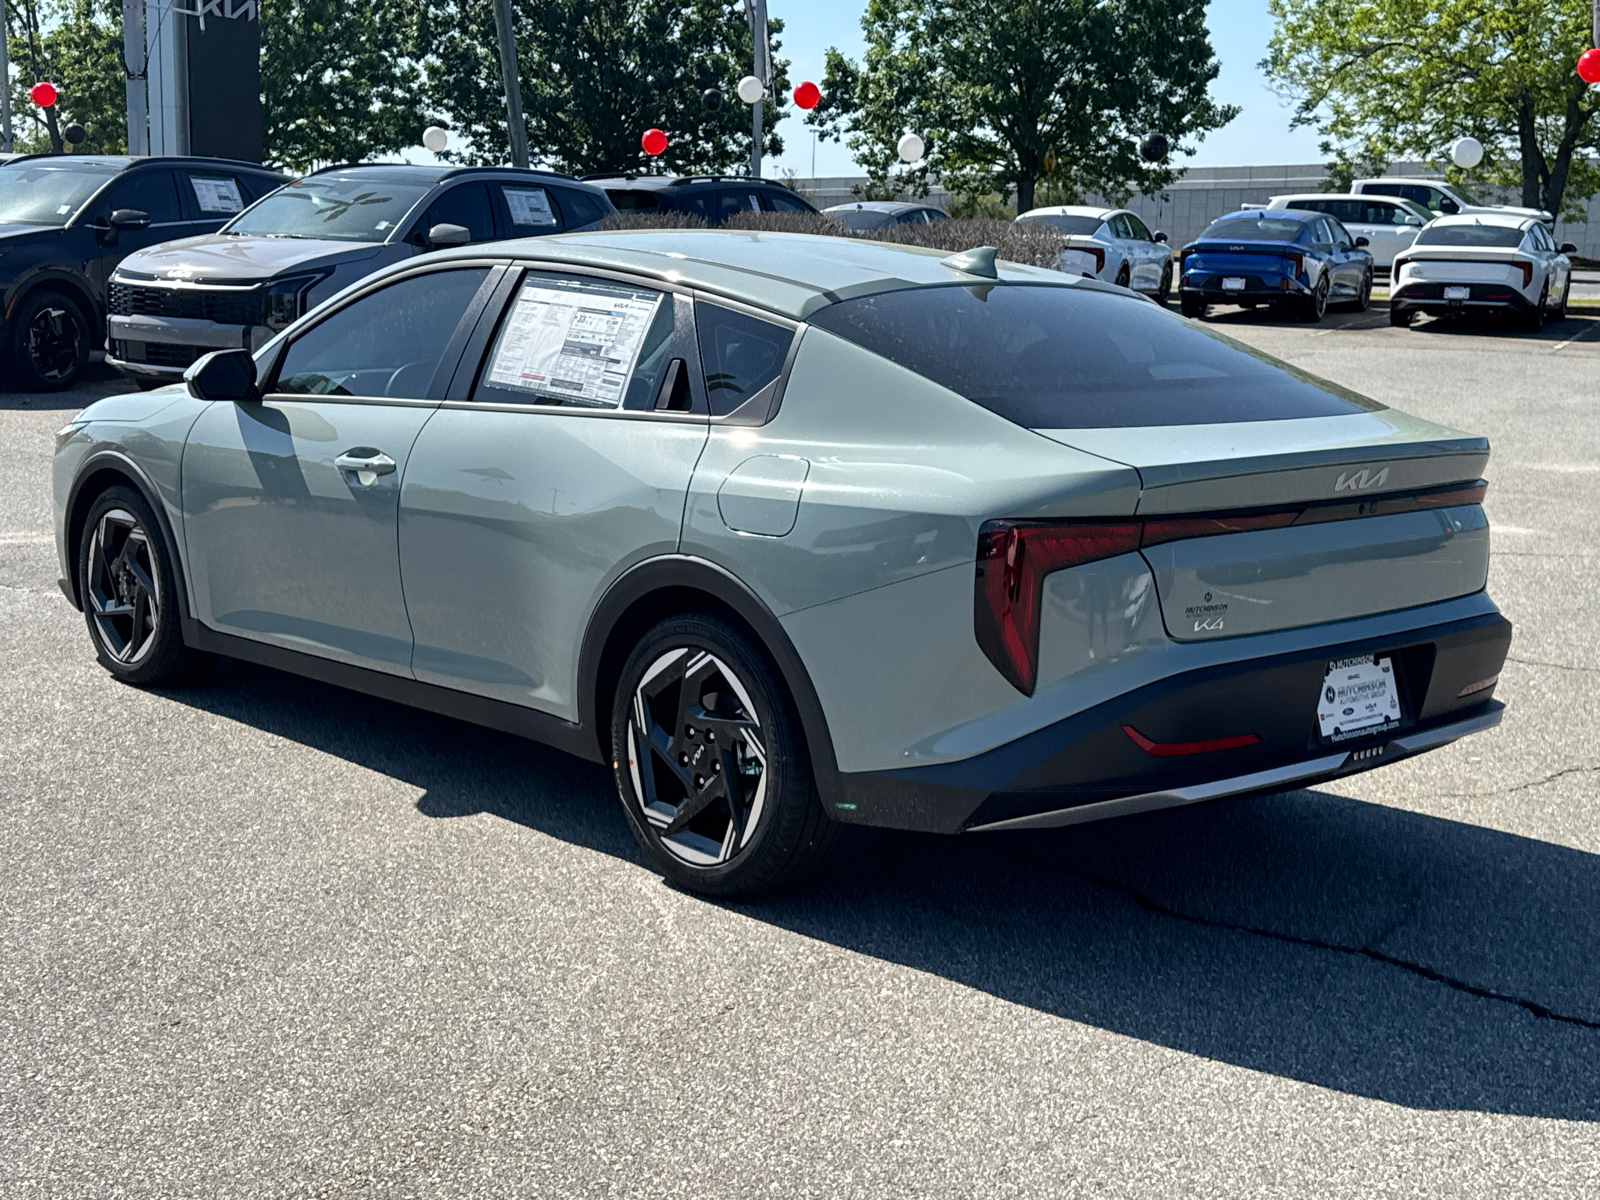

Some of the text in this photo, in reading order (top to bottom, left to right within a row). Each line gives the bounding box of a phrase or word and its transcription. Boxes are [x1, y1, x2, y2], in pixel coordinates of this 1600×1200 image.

[1334, 467, 1390, 492] KIA
[1185, 603, 1228, 613] HUTCHINSON
[1194, 618, 1223, 631] K4
[1337, 655, 1374, 669] HUTCHINSON
[1338, 679, 1386, 698] HUTCHINSON
